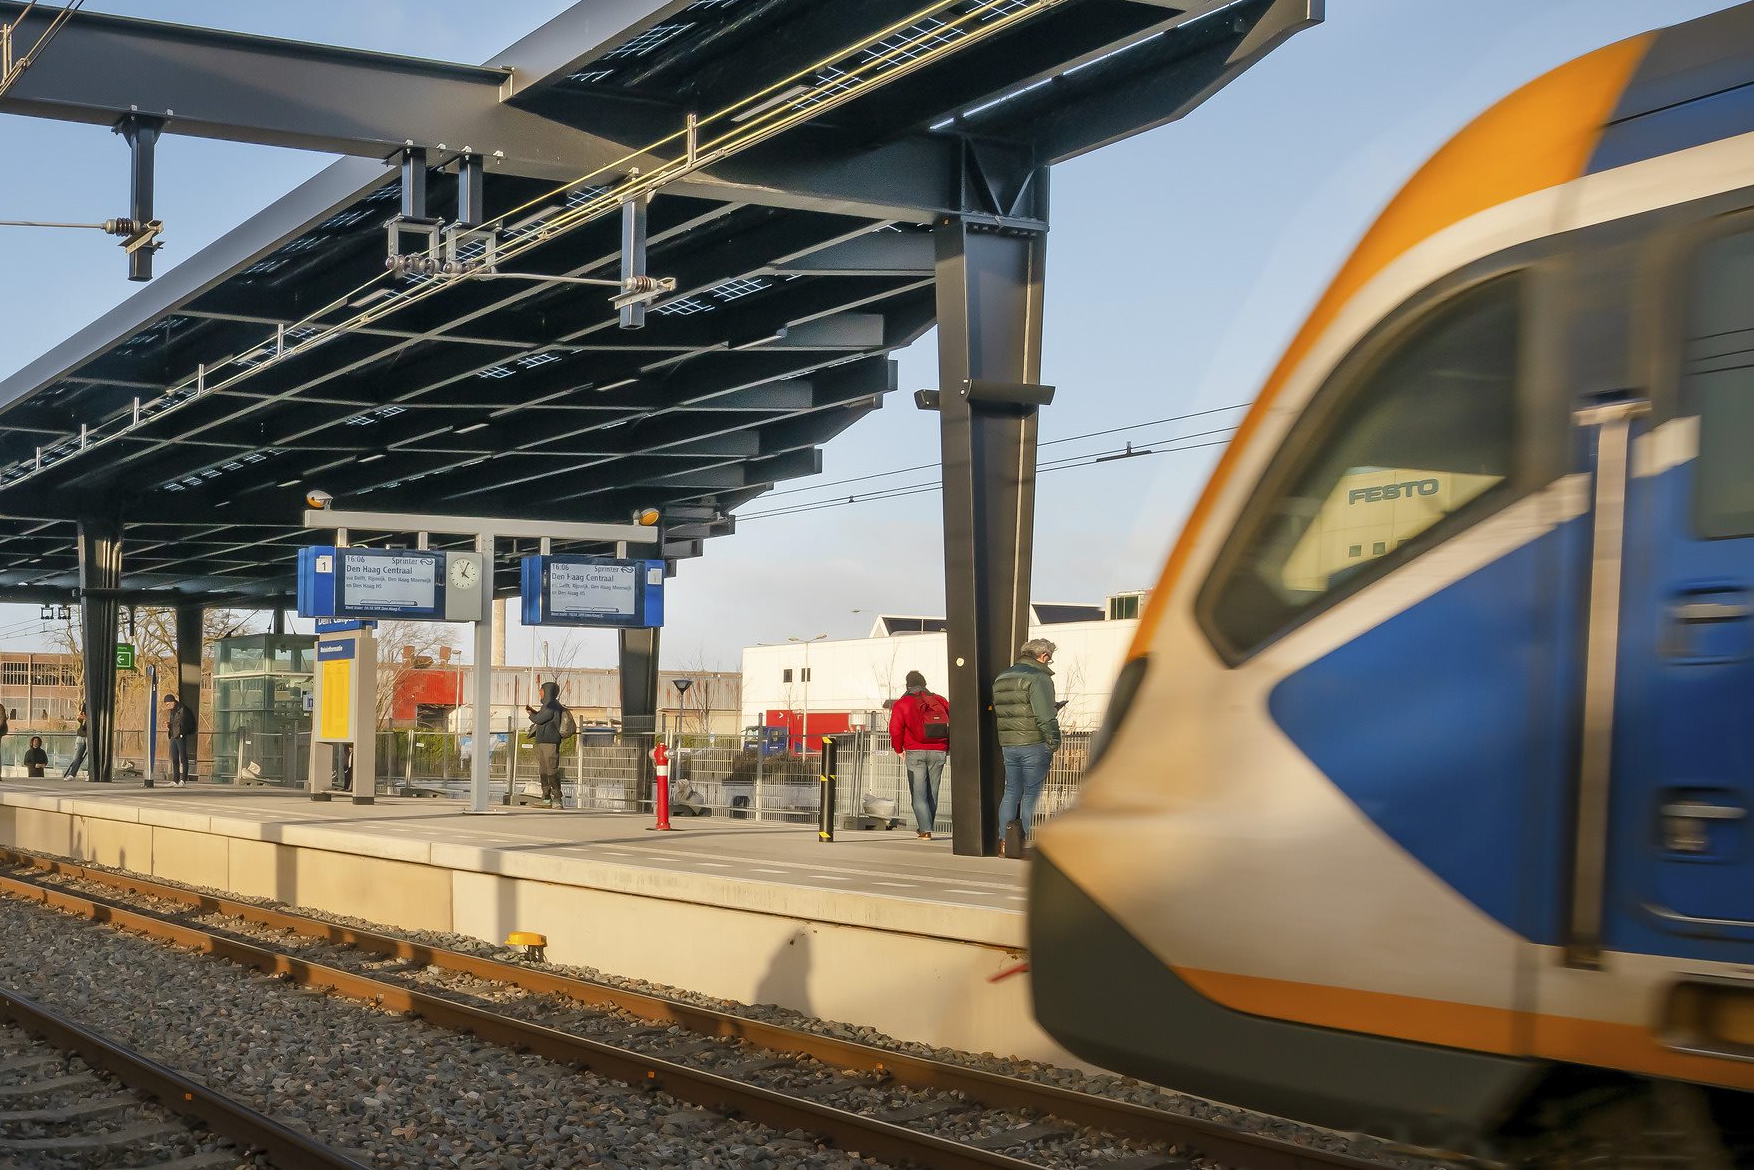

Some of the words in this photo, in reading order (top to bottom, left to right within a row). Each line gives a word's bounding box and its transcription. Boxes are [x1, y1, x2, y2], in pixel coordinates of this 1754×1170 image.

[1348, 478, 1439, 505] FESTO
[322, 562, 326, 571] 1
[362, 566, 381, 575] Haag
[383, 566, 413, 574] Centraal
[567, 573, 584, 582] Haag
[586, 574, 614, 582] Centraal
